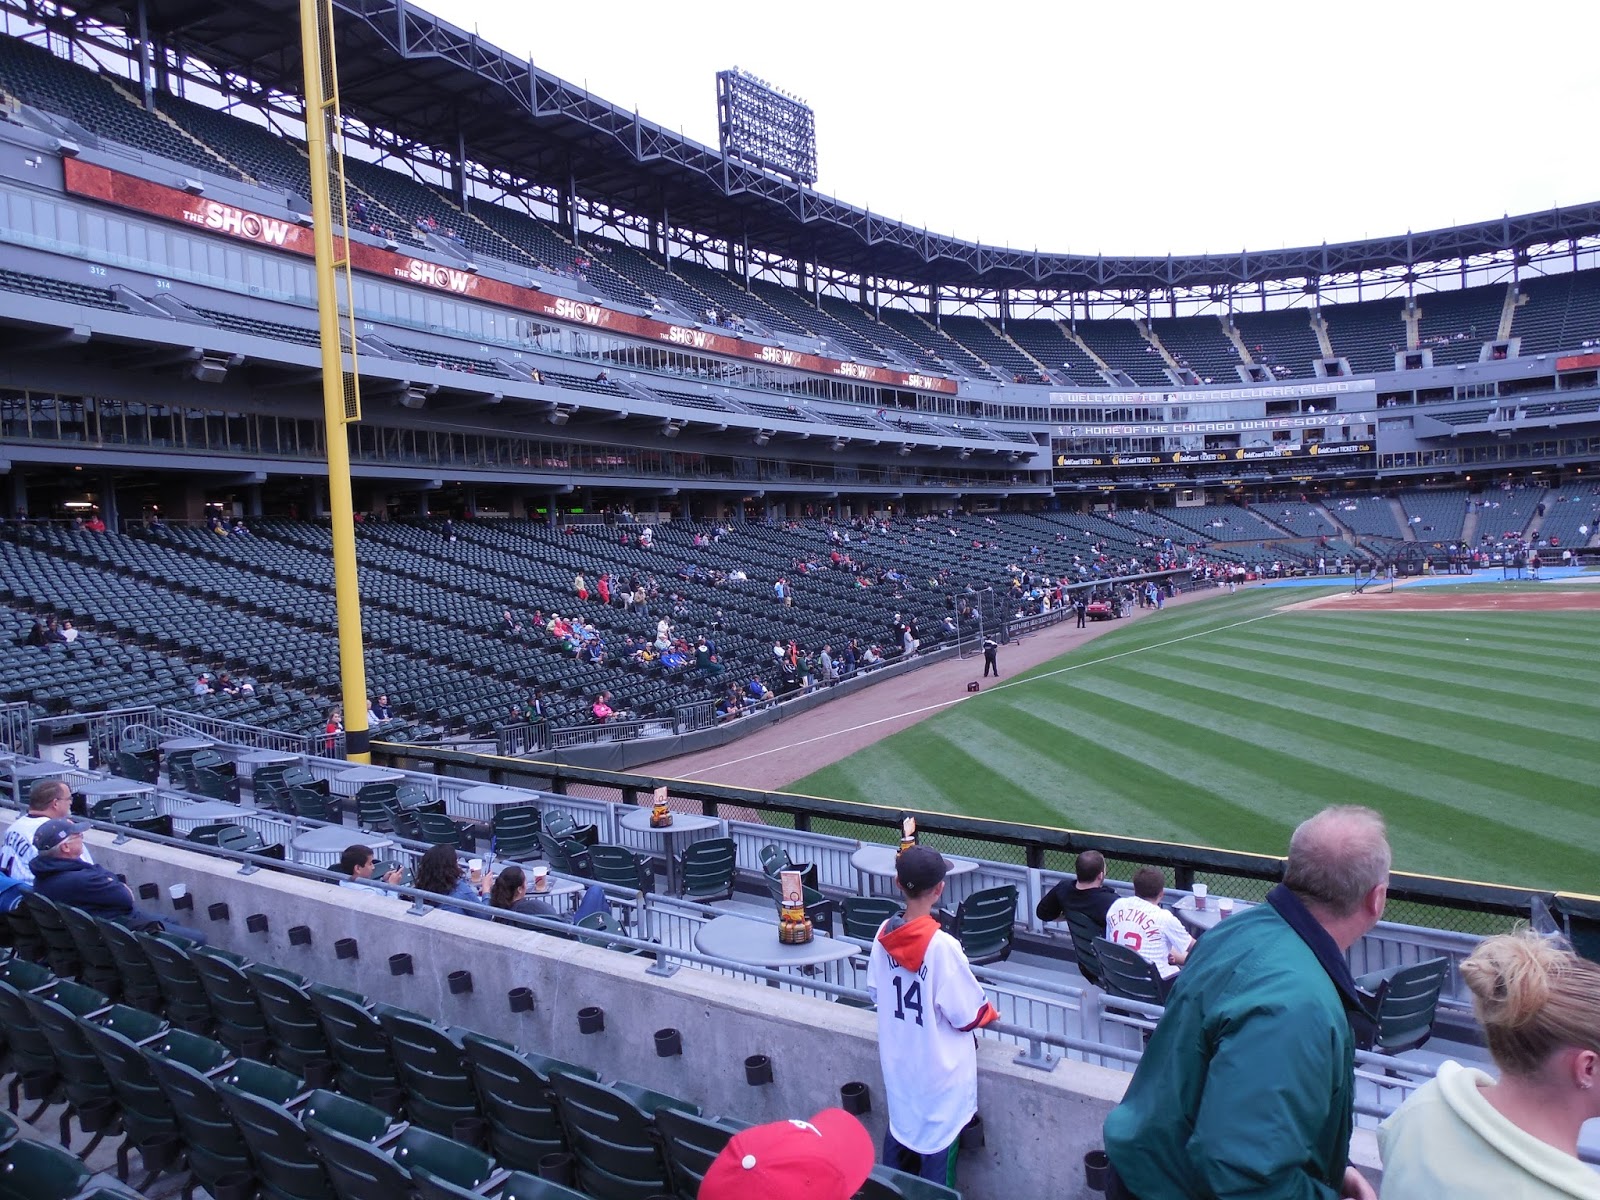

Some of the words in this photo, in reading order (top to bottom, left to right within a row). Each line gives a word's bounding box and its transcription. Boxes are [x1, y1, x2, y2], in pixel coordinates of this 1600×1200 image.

[183, 210, 204, 224] THE
[206, 203, 289, 245] SHOW
[90, 266, 106, 276] 312
[394, 267, 409, 278] THE
[410, 259, 469, 292] SHOW
[156, 280, 171, 289] 314
[555, 299, 601, 324] SHOW
[670, 325, 706, 347] SHOW
[762, 346, 793, 365] SHOW
[841, 362, 867, 378] SHOW
[909, 374, 933, 389] SHOW
[1068, 394, 1134, 402] WELCOME
[1140, 393, 1158, 402] TO
[1210, 387, 1295, 400] CELLULAR
[1301, 383, 1349, 395] FIELD
[1086, 426, 1121, 435] HOME
[1124, 425, 1141, 434] OF
[1145, 425, 1168, 434] THE
[1173, 422, 1235, 433] CHICAGO
[1241, 419, 1289, 430] WHITE
[1294, 416, 1328, 427] SOX
[892, 975, 924, 1028] 14
